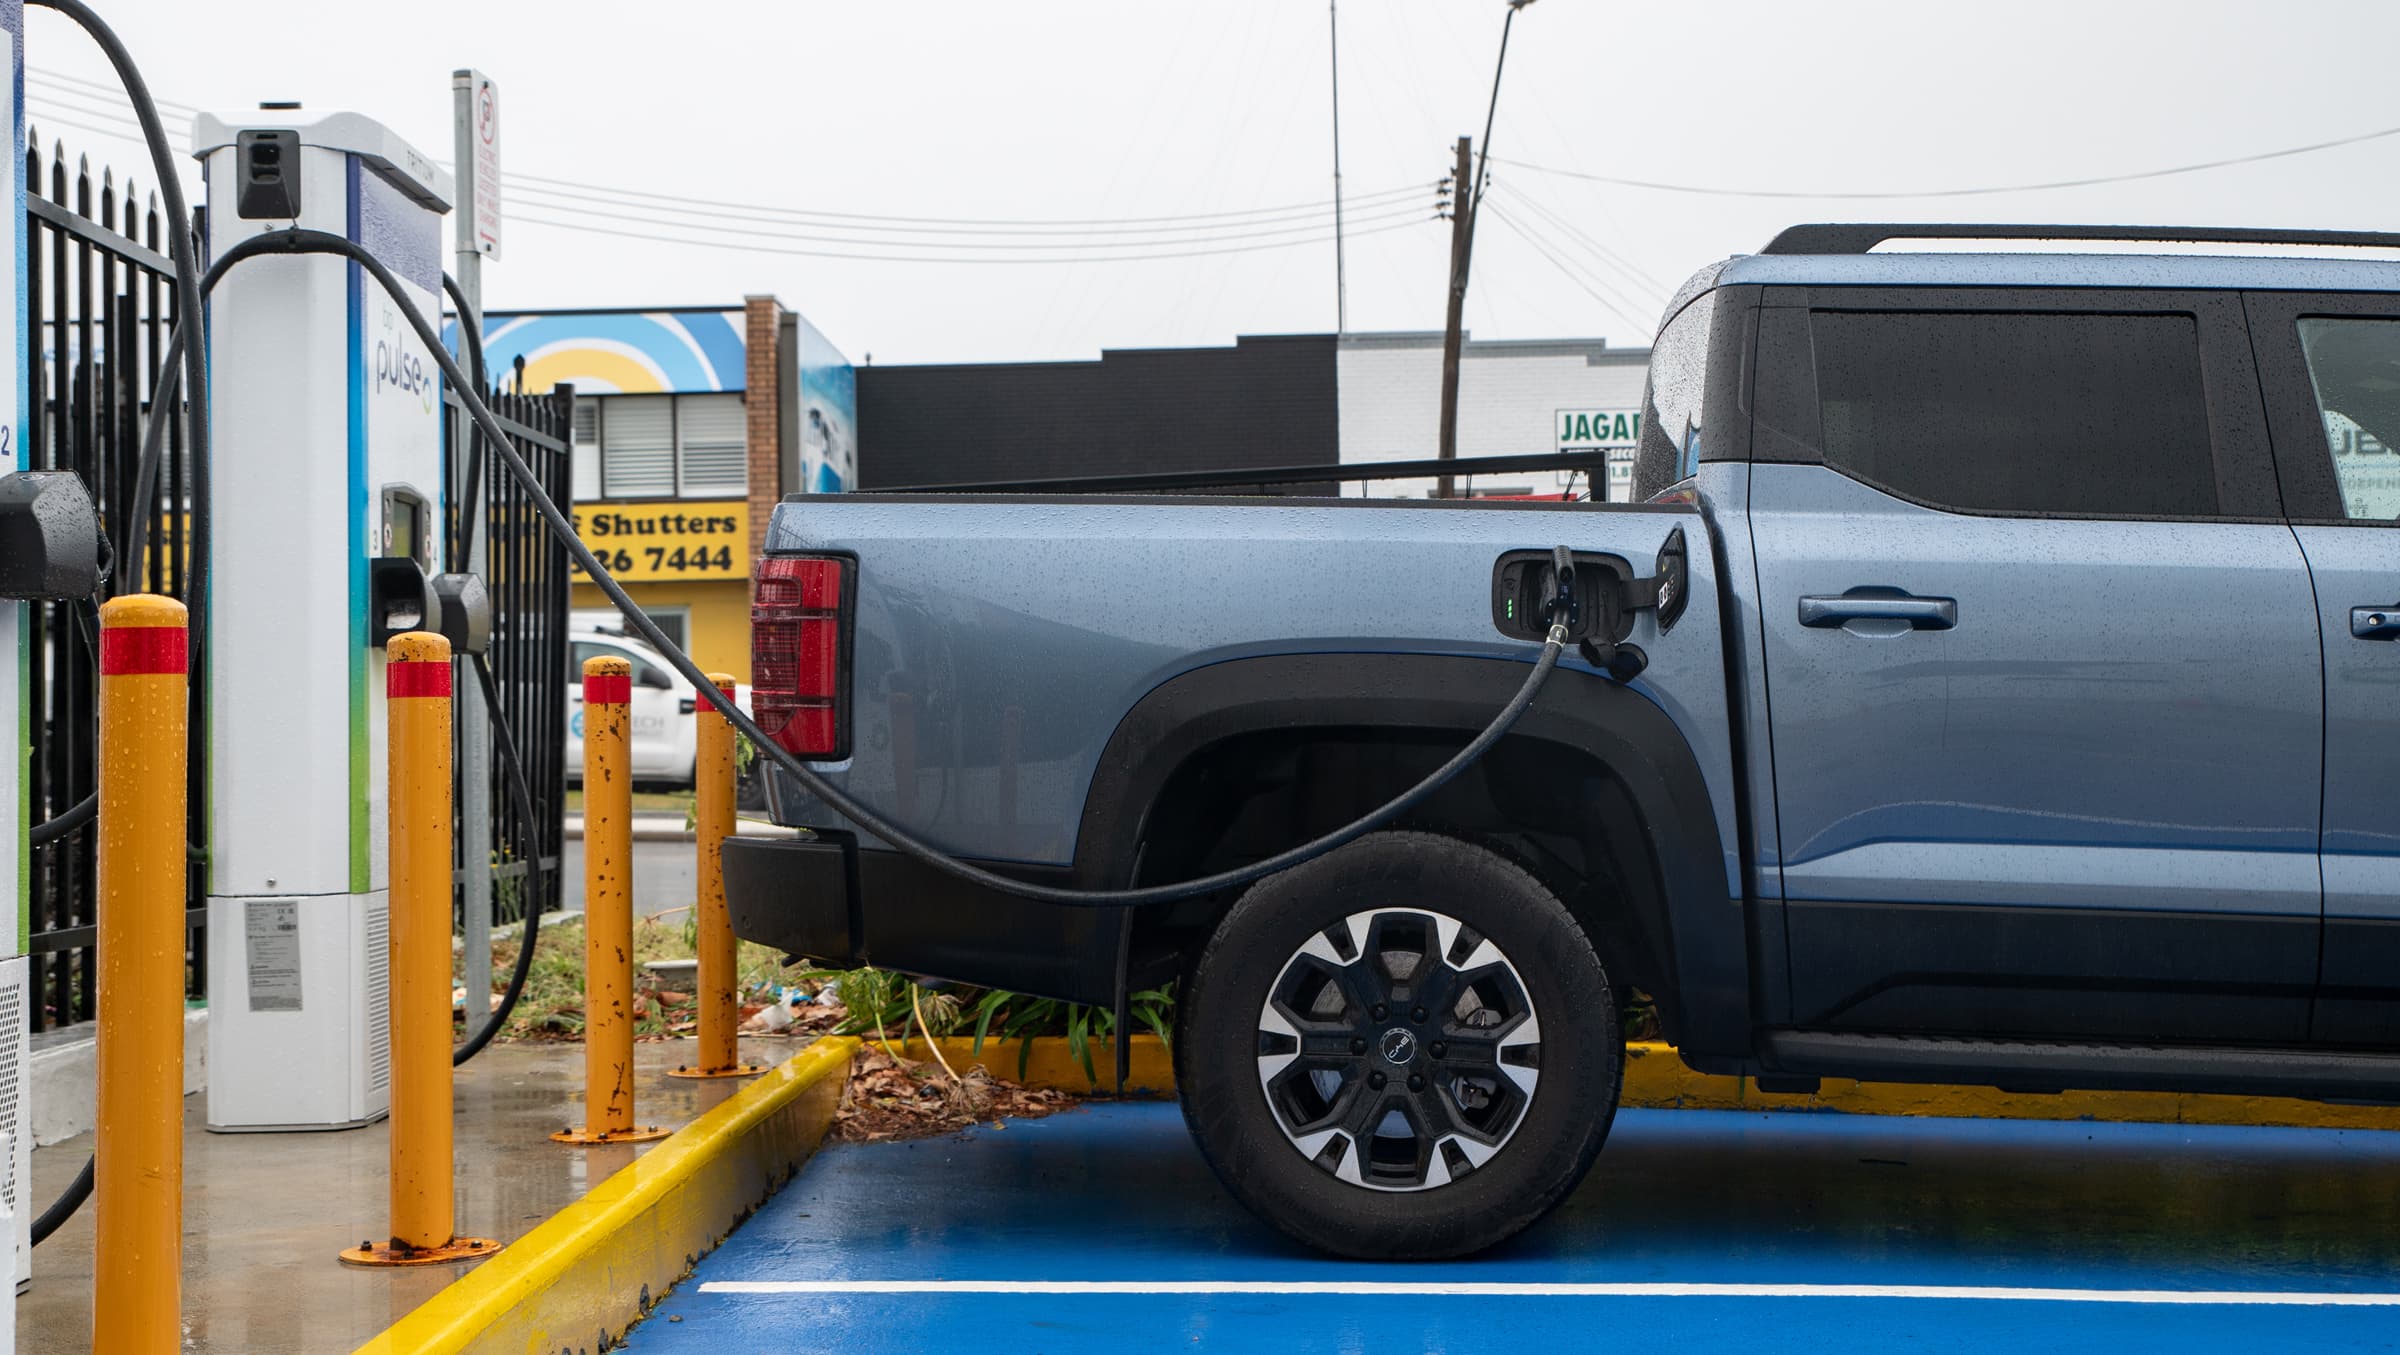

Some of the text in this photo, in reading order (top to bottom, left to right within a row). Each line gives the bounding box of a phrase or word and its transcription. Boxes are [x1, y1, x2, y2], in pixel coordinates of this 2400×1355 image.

[376, 330, 421, 396] pulse
[1, 425, 10, 456] 2
[591, 513, 736, 537] Shutters
[645, 544, 732, 572] 7444
